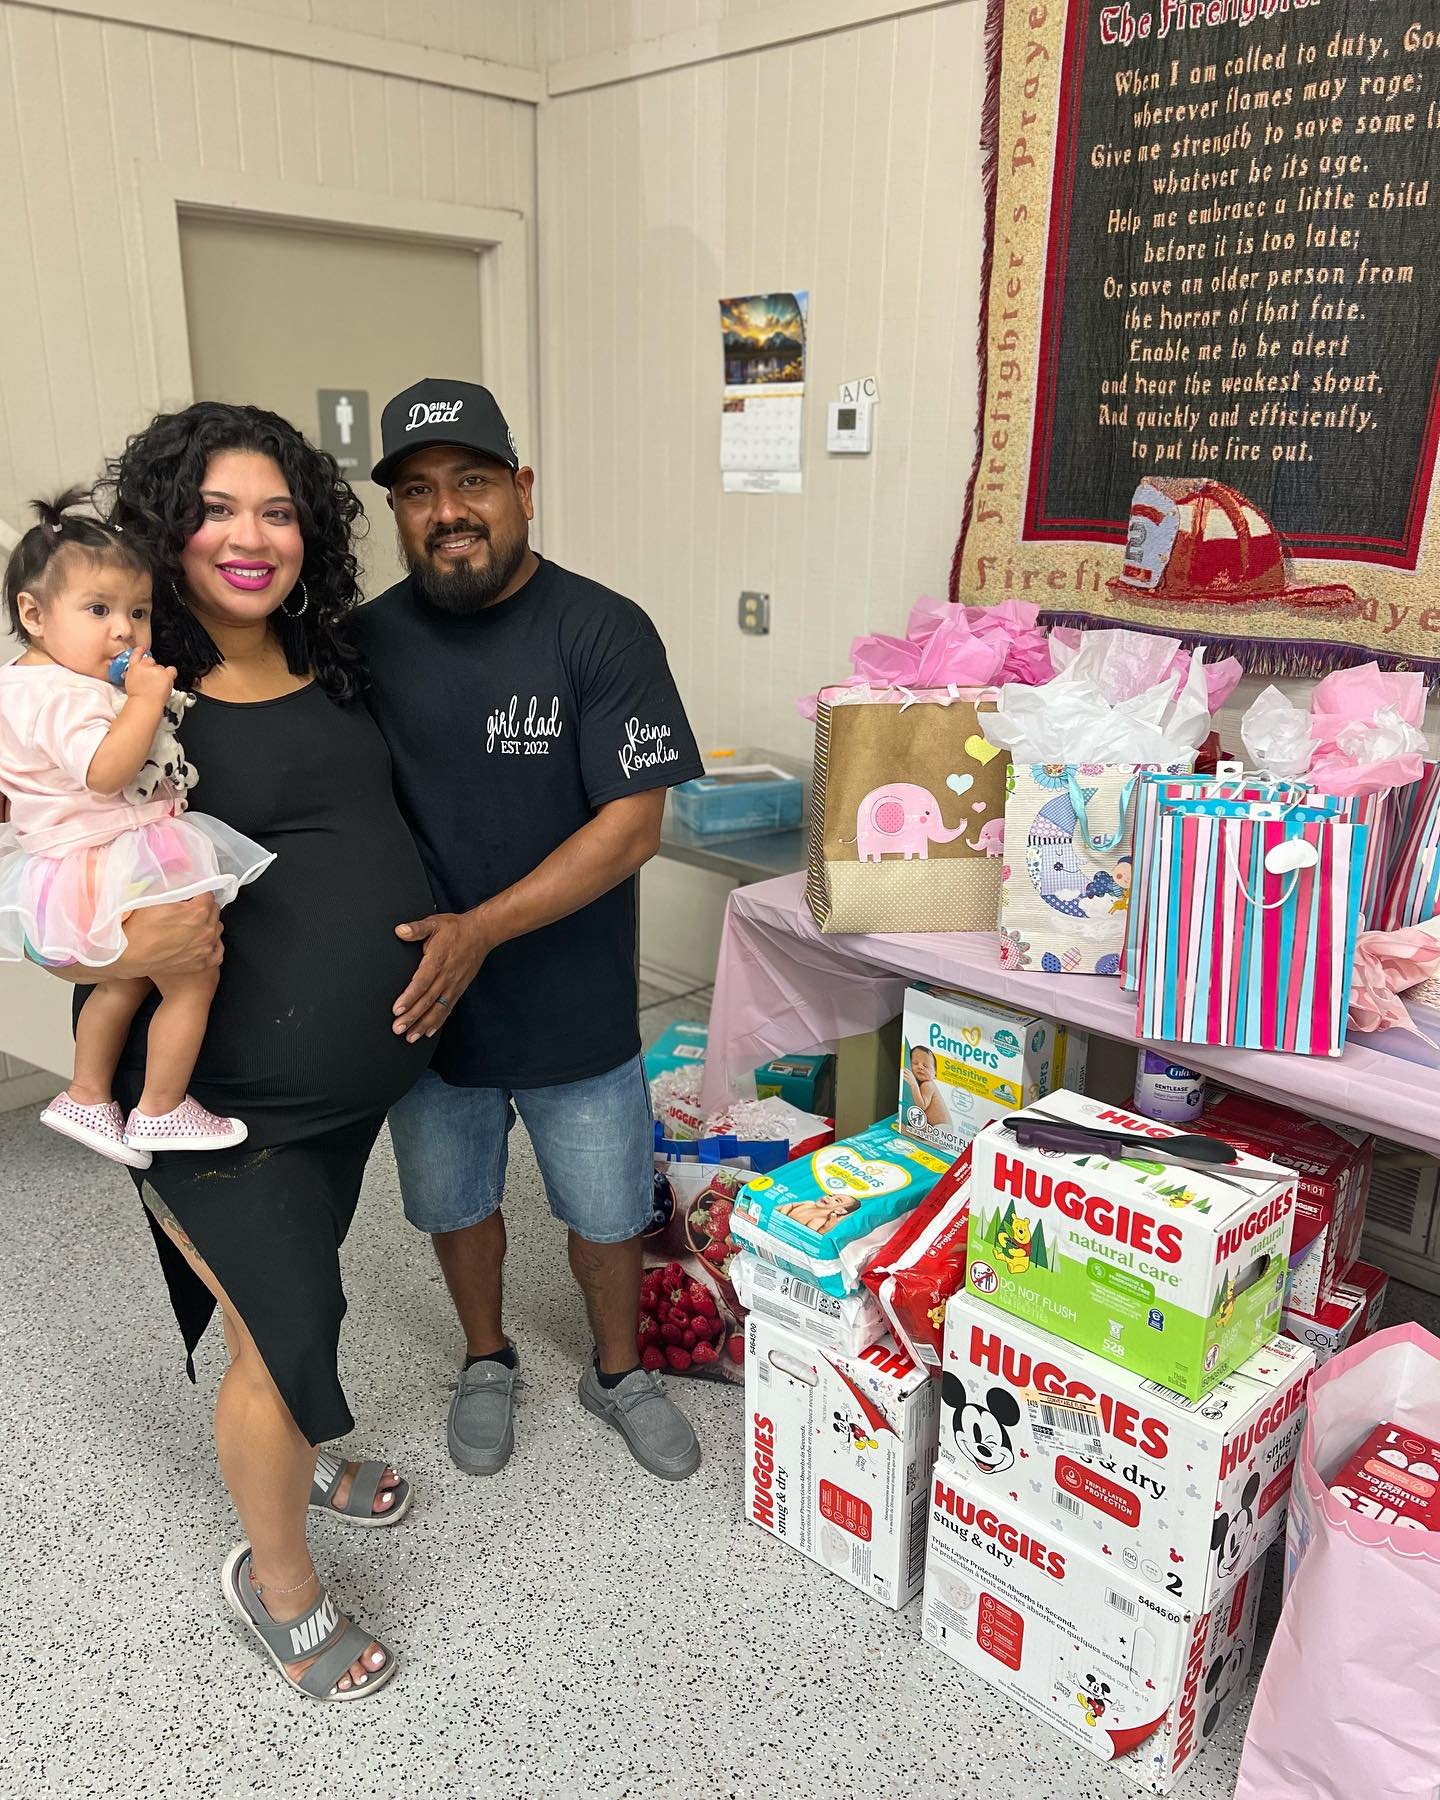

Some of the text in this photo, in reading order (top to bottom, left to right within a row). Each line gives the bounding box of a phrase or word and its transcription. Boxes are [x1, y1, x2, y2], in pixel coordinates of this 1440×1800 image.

[1100, 6, 1151, 47] The
[1115, 68, 1160, 97] When
[1169, 59, 1180, 87] I
[1190, 66, 1217, 84] am
[1224, 42, 1287, 77] called
[1299, 44, 1316, 65] to
[1326, 30, 1389, 62] duty,
[1133, 72, 1423, 129] wherever flames may rage;
[1090, 142, 1131, 169] Give
[1138, 144, 1160, 162] me
[1171, 126, 1253, 161] strength
[1264, 124, 1283, 146] to
[1293, 116, 1343, 140] save
[1355, 111, 1415, 134] some
[1152, 153, 1369, 196] whatever be its age.
[1107, 181, 1429, 236] Help me embrace a little child
[1144, 224, 1361, 263] before it is too late;
[1104, 256, 1414, 300] Or save an older person from
[1124, 294, 1366, 330] the horror of that fate.
[1129, 333, 1350, 363] Enable me to be alert
[843, 378, 876, 402] A/C
[1101, 368, 1383, 396] and hear the weakest shout,
[405, 400, 464, 432] Dad
[429, 401, 452, 411] GIRL
[1099, 402, 1378, 432] And quickly and efficiently,
[1131, 437, 1314, 463] to put the fire out.
[1125, 522, 1147, 562] 2
[487, 694, 562, 754] girl dad
[625, 717, 671, 751] Reina
[501, 741, 549, 755] EST 2022
[618, 738, 679, 779] Rosalia
[929, 1023, 999, 1070] Pampers
[944, 1060, 989, 1085] Sensitive
[927, 1125, 940, 1137] DO
[941, 1131, 957, 1144] NOT
[832, 1155, 884, 1188] Pampers
[993, 1152, 1183, 1264] HUGGIES
[1216, 1186, 1293, 1265] HUGGIES
[936, 1215, 968, 1249] Project Hug
[1250, 1220, 1285, 1257] natural
[1069, 1230, 1134, 1268] natural
[1139, 1261, 1179, 1288] care
[1000, 1277, 1016, 1292] DO
[1018, 1286, 1040, 1302] NOT
[1043, 1297, 1077, 1323] FLUSH
[1103, 1339, 1125, 1356] 528
[1262, 1344, 1296, 1360] HUGGIES
[1265, 1428, 1292, 1465] snug
[1272, 1447, 1292, 1473] dry
[753, 1412, 775, 1530] HUGGIES
[1122, 1464, 1167, 1500] dry
[1357, 1470, 1429, 1508] snugglers
[777, 1466, 790, 1536] snug & dry
[1084, 1485, 1133, 1517] PROTECTION
[1085, 1478, 1128, 1506] TRIPLE LAYER
[1369, 1485, 1406, 1508] little
[934, 1479, 1067, 1580] HUGGIES
[1277, 1508, 1286, 1531] 2
[933, 1510, 1013, 1568] snug & dry
[1124, 1550, 1137, 1561] 100
[873, 1572, 885, 1583] 1
[931, 1535, 1078, 1632] Triple Layer Protection Absorbs in Seconds.
[1165, 1571, 1183, 1598] 2
[931, 1543, 939, 1552] La
[939, 1550, 974, 1575] protection
[980, 1575, 997, 1588] trois
[997, 1586, 1026, 1607] couches
[1026, 1605, 1056, 1626] absorbe
[1056, 1623, 1066, 1633] en
[1067, 1629, 1101, 1654] quelques
[941, 1626, 947, 1639] 1
[1172, 1613, 1212, 1775] HUGGIES
